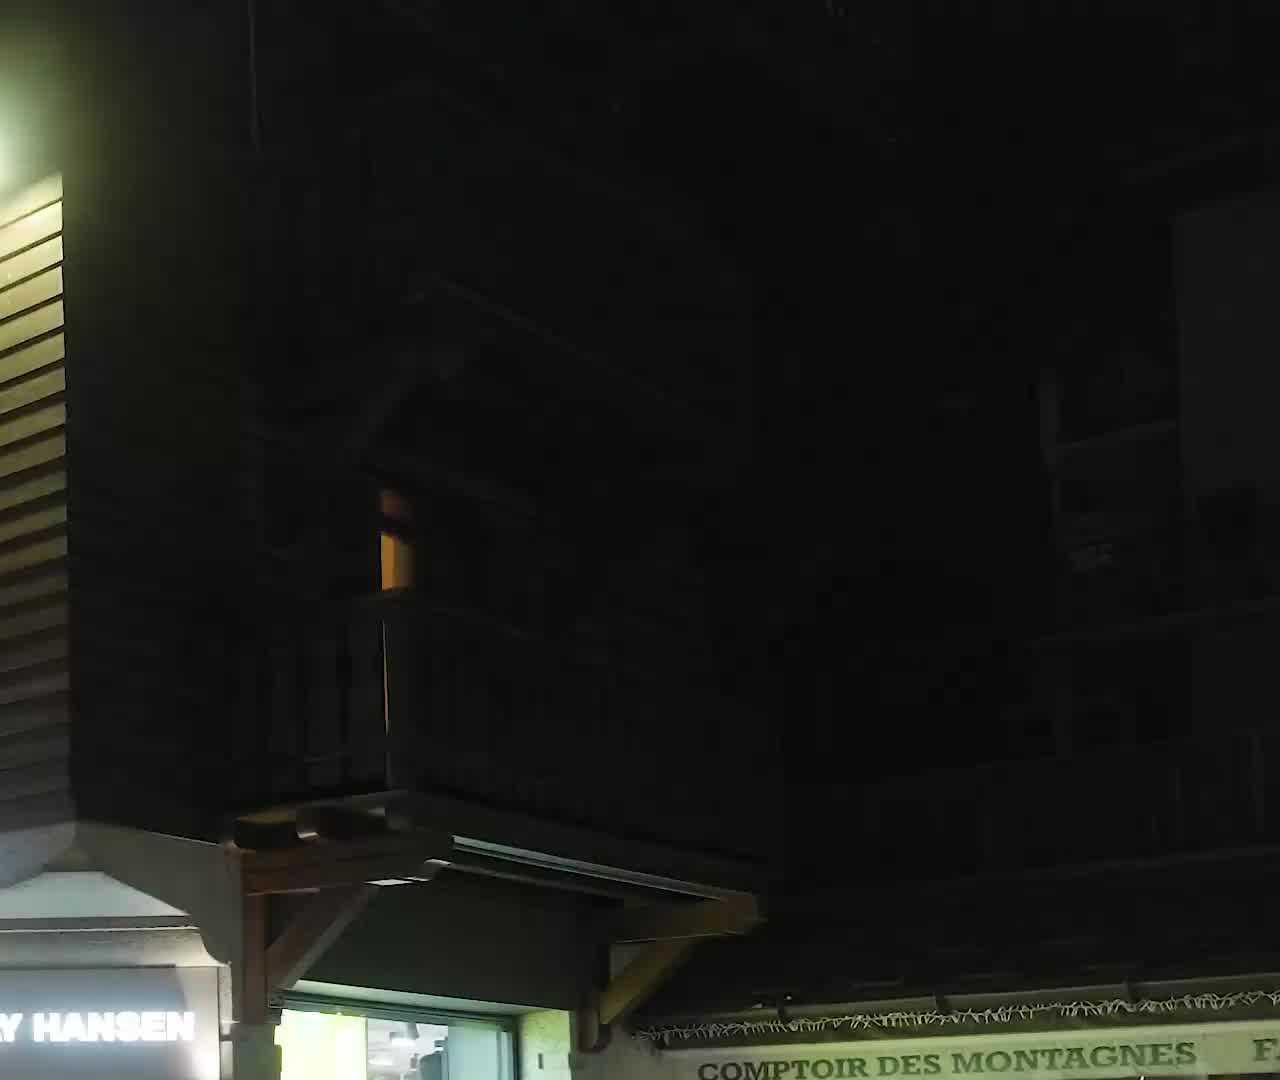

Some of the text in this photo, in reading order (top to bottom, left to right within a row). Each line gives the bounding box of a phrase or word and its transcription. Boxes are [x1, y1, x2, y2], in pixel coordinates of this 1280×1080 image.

[32, 1011, 195, 1042] HANSEN
[876, 1053, 941, 1077] DES
[951, 1040, 1198, 1074] MONTAGNES
[1252, 1037, 1280, 1063] F
